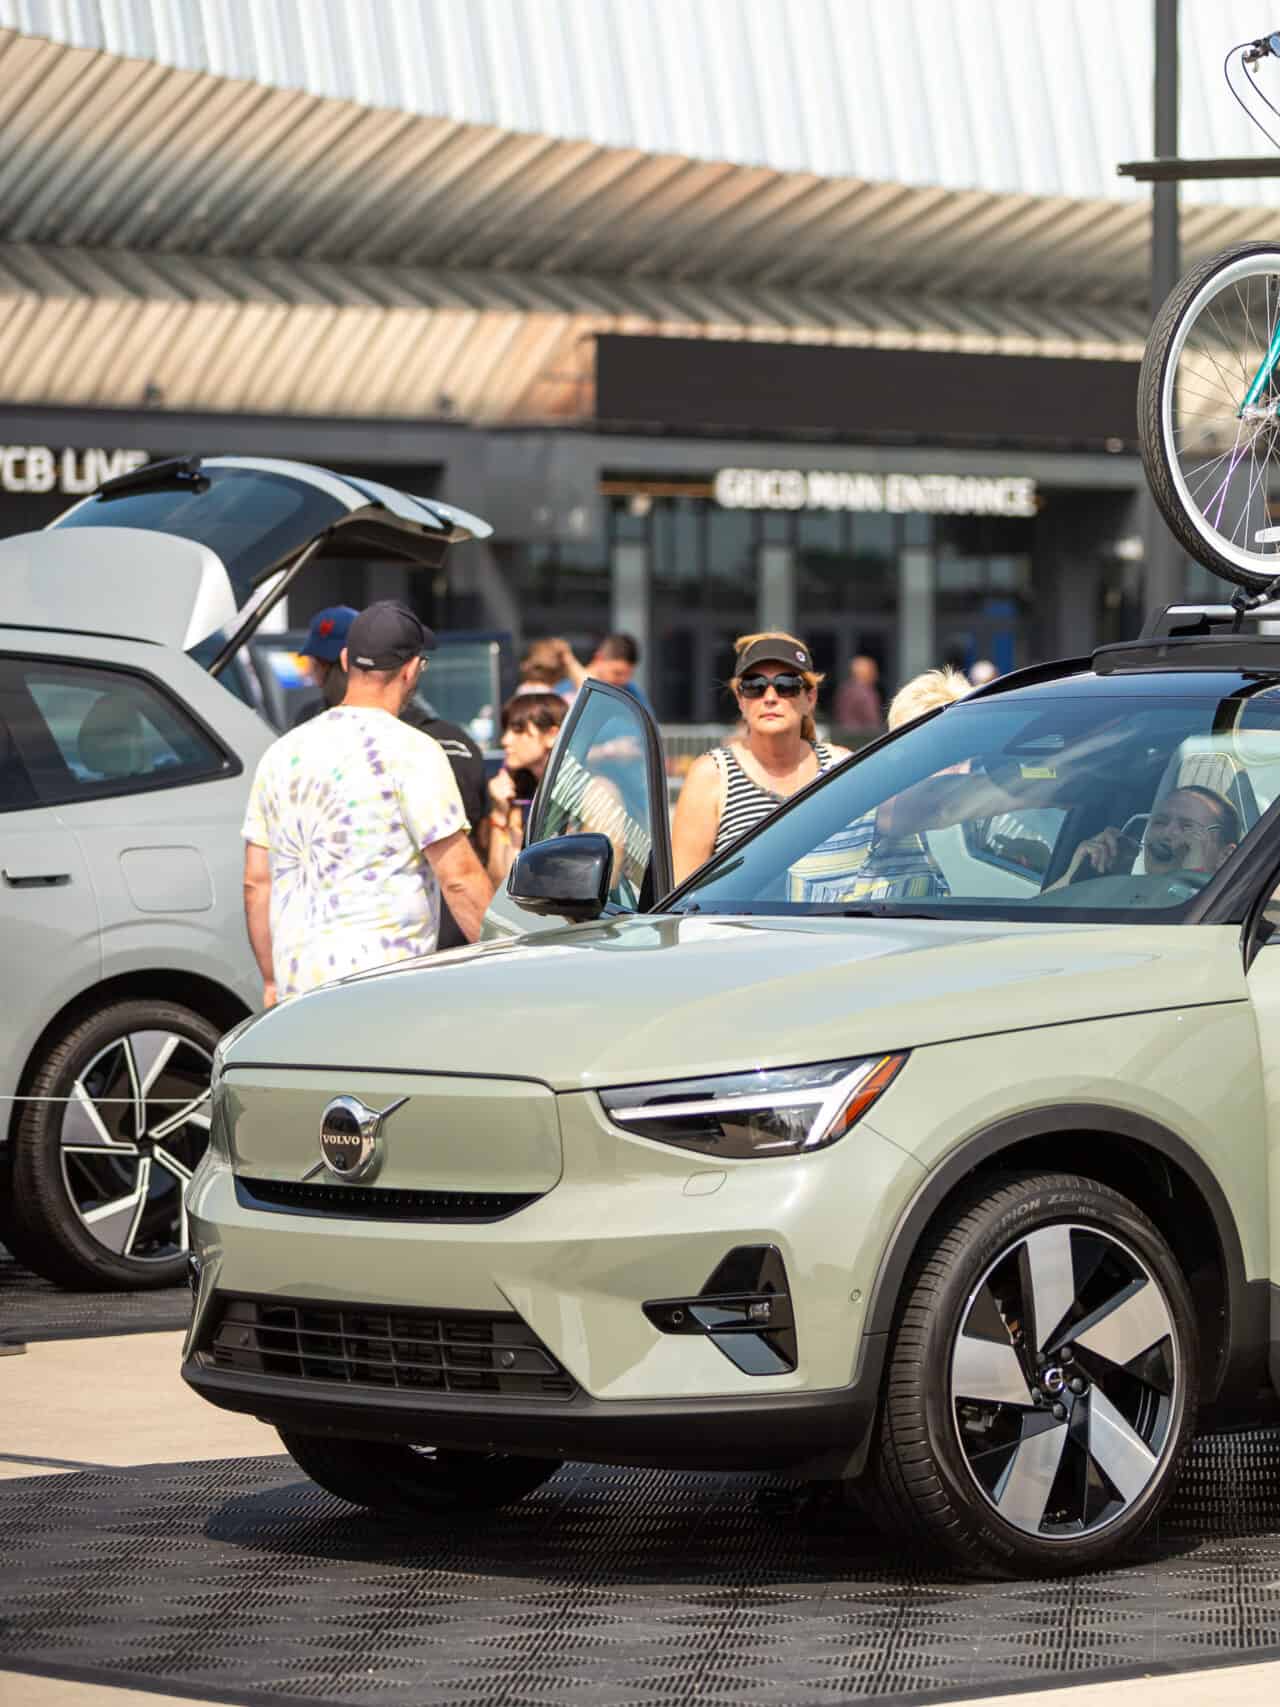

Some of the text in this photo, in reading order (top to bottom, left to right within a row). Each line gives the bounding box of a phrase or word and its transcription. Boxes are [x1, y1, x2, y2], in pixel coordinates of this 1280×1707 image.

[0, 446, 55, 492] CB
[886, 474, 1037, 516] ENTRANCE
[322, 1135, 361, 1145] VOLVO
